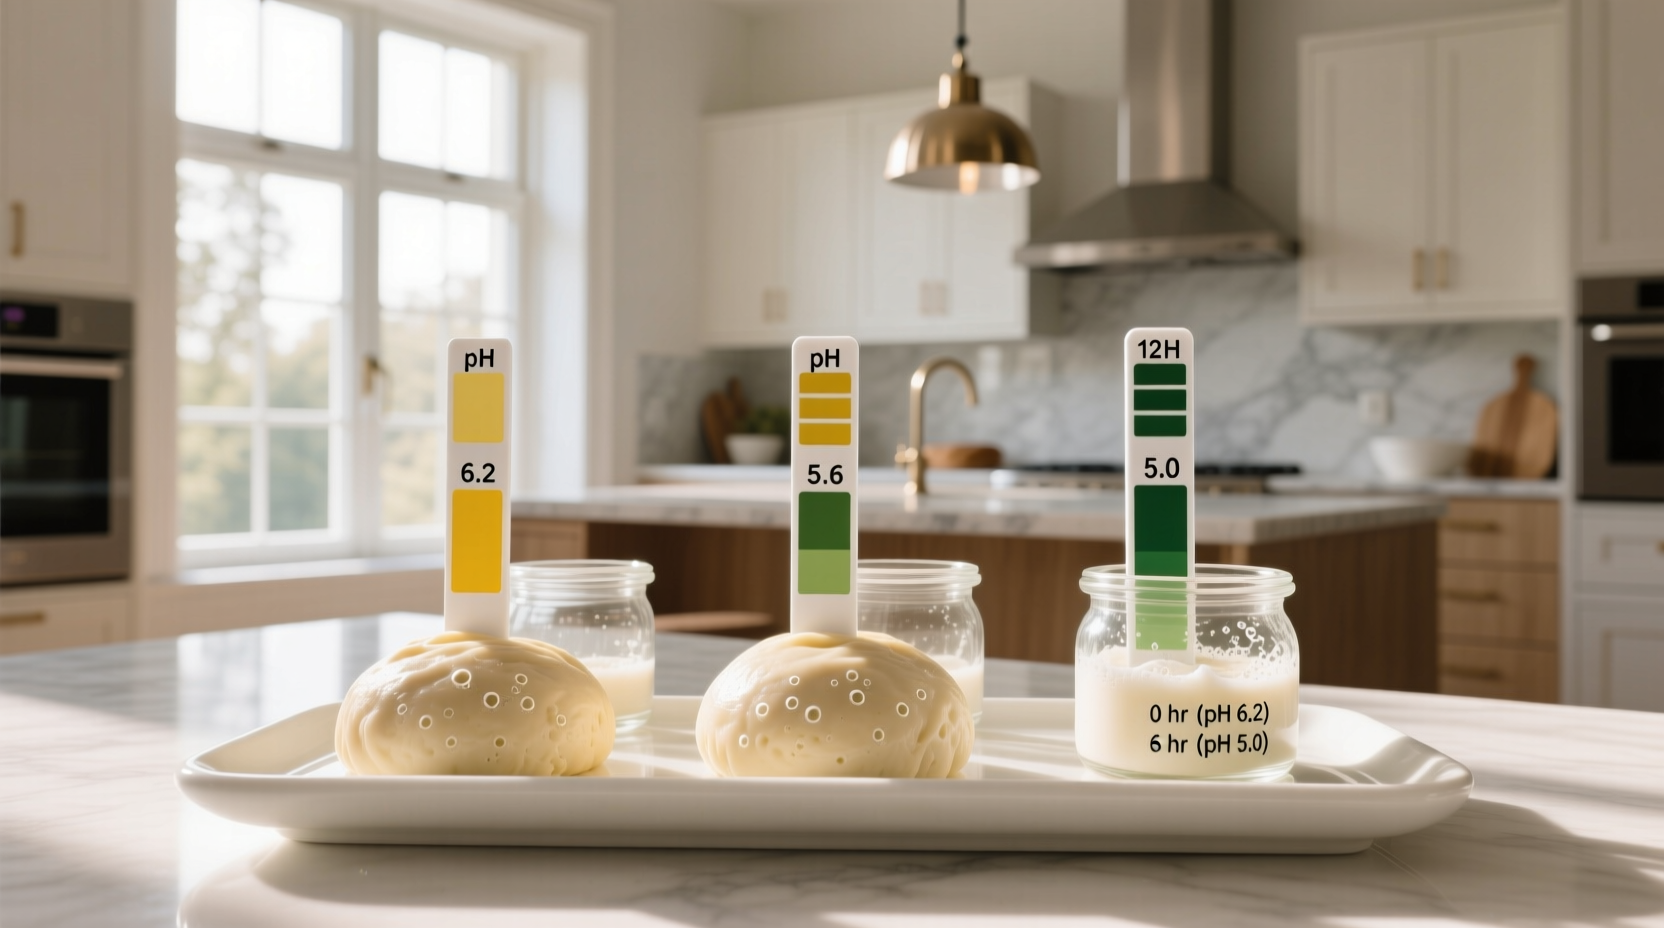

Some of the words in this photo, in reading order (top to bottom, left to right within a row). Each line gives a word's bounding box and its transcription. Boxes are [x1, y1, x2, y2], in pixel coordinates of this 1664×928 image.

[464, 348, 495, 373] pH
[809, 348, 840, 373] pH
[1137, 339, 1181, 360] 12H
[460, 462, 496, 484] 6.2
[807, 464, 844, 485] 5.6
[1144, 456, 1181, 479] 5.0
[1149, 704, 1162, 724] 0
[1168, 703, 1189, 723] hr
[1196, 703, 1231, 728] (pH
[1236, 701, 1270, 726] 6.2)
[1149, 734, 1162, 754] 6
[1168, 733, 1189, 754] hr
[1196, 733, 1231, 758] (pH
[1236, 730, 1269, 755] 5.0)
